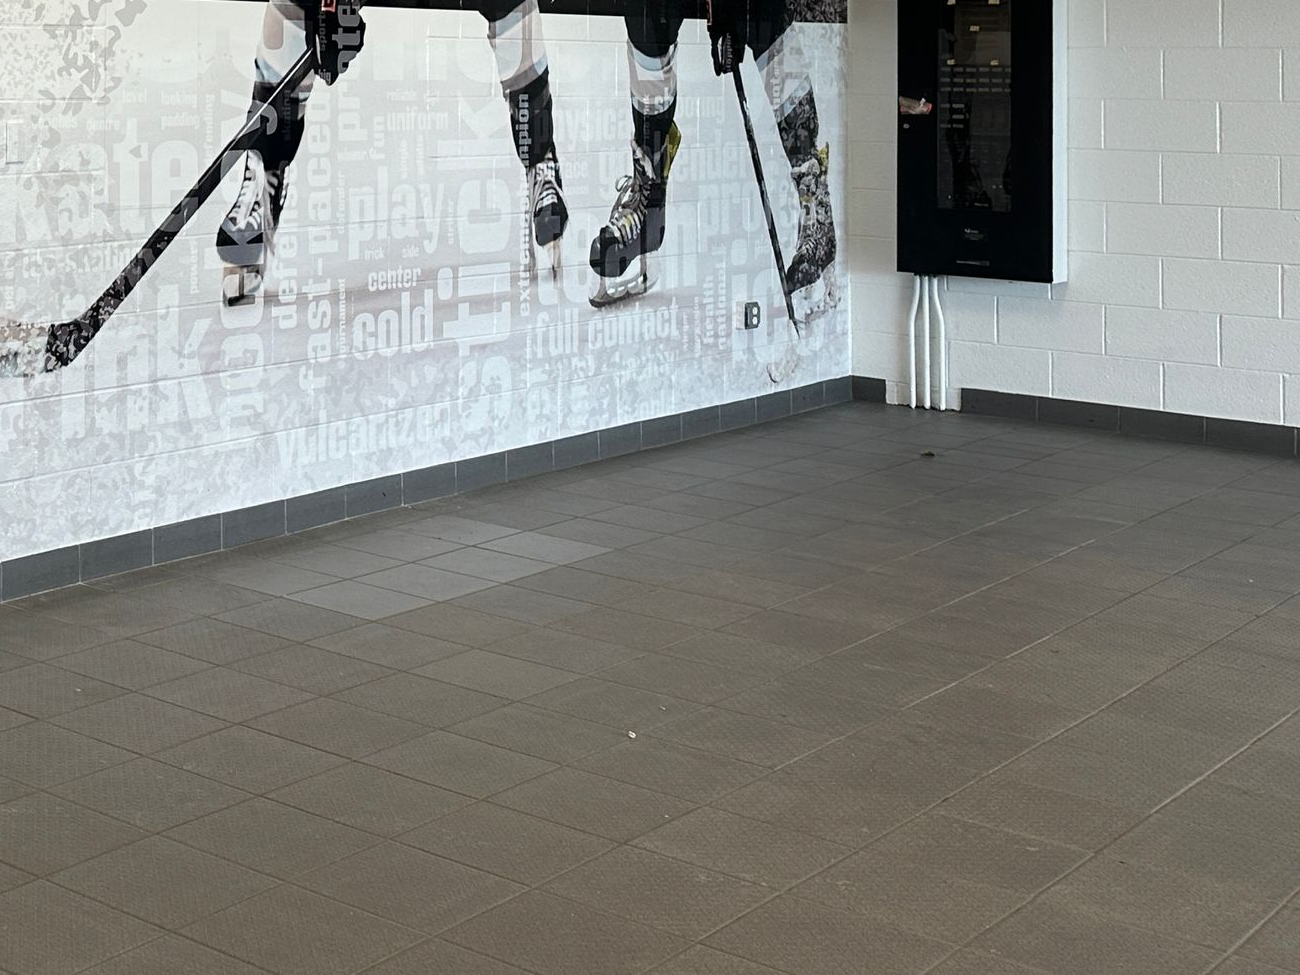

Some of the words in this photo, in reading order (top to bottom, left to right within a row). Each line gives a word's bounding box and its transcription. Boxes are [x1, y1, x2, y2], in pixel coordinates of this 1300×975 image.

[160, 91, 198, 108] looking
[386, 106, 449, 132] uniform
[534, 99, 631, 156] physica
[369, 116, 386, 159] fun
[299, 91, 338, 391] fast-paced
[347, 166, 444, 260] play
[367, 264, 422, 292] center
[402, 243, 420, 258] side
[436, 92, 512, 433] stick
[337, 277, 346, 358] tournament
[352, 288, 435, 360] cold
[536, 307, 580, 359] full
[587, 296, 681, 350] contact
[703, 275, 714, 345] health
[716, 256, 727, 350] national
